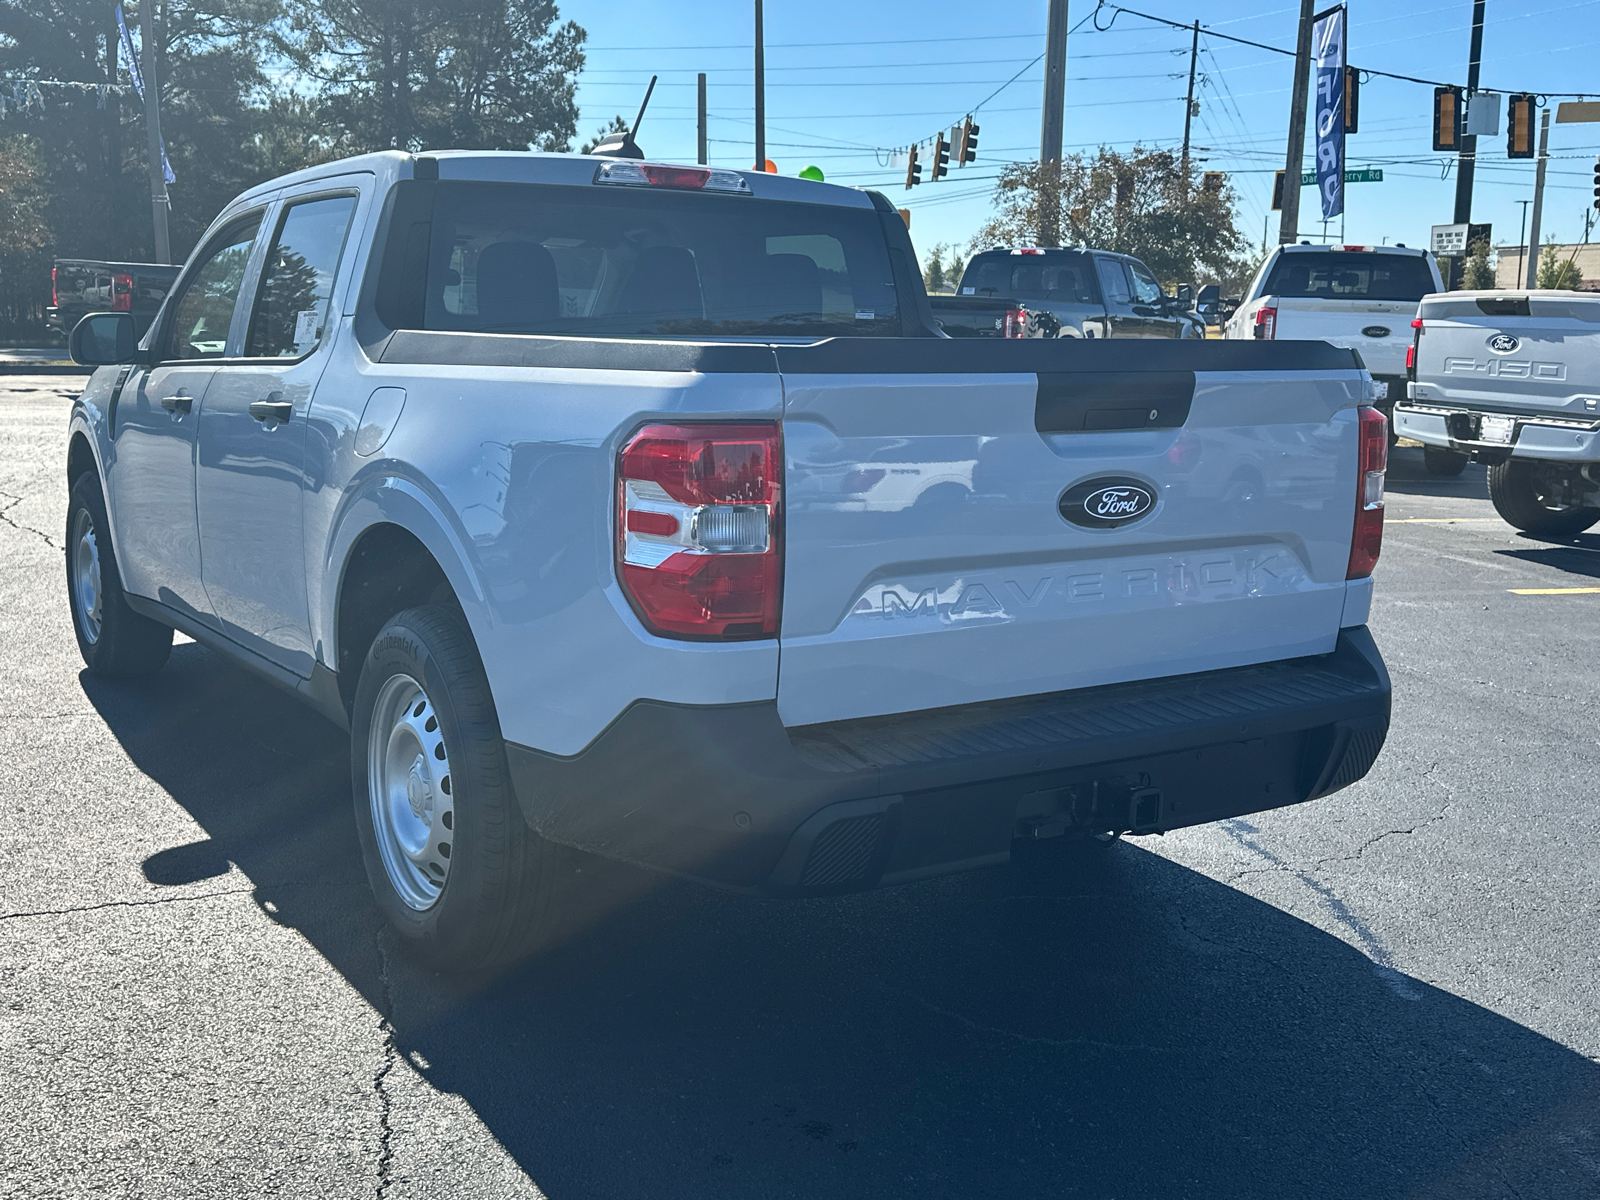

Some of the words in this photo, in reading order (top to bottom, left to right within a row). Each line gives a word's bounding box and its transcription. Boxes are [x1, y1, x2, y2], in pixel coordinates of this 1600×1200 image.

[1368, 171, 1380, 180] Rd
[1494, 335, 1513, 350] Ford
[1444, 357, 1567, 381] F-150
[1097, 491, 1139, 514] Ford
[881, 555, 1281, 621] MAVERICK
[373, 632, 413, 660] Continental
